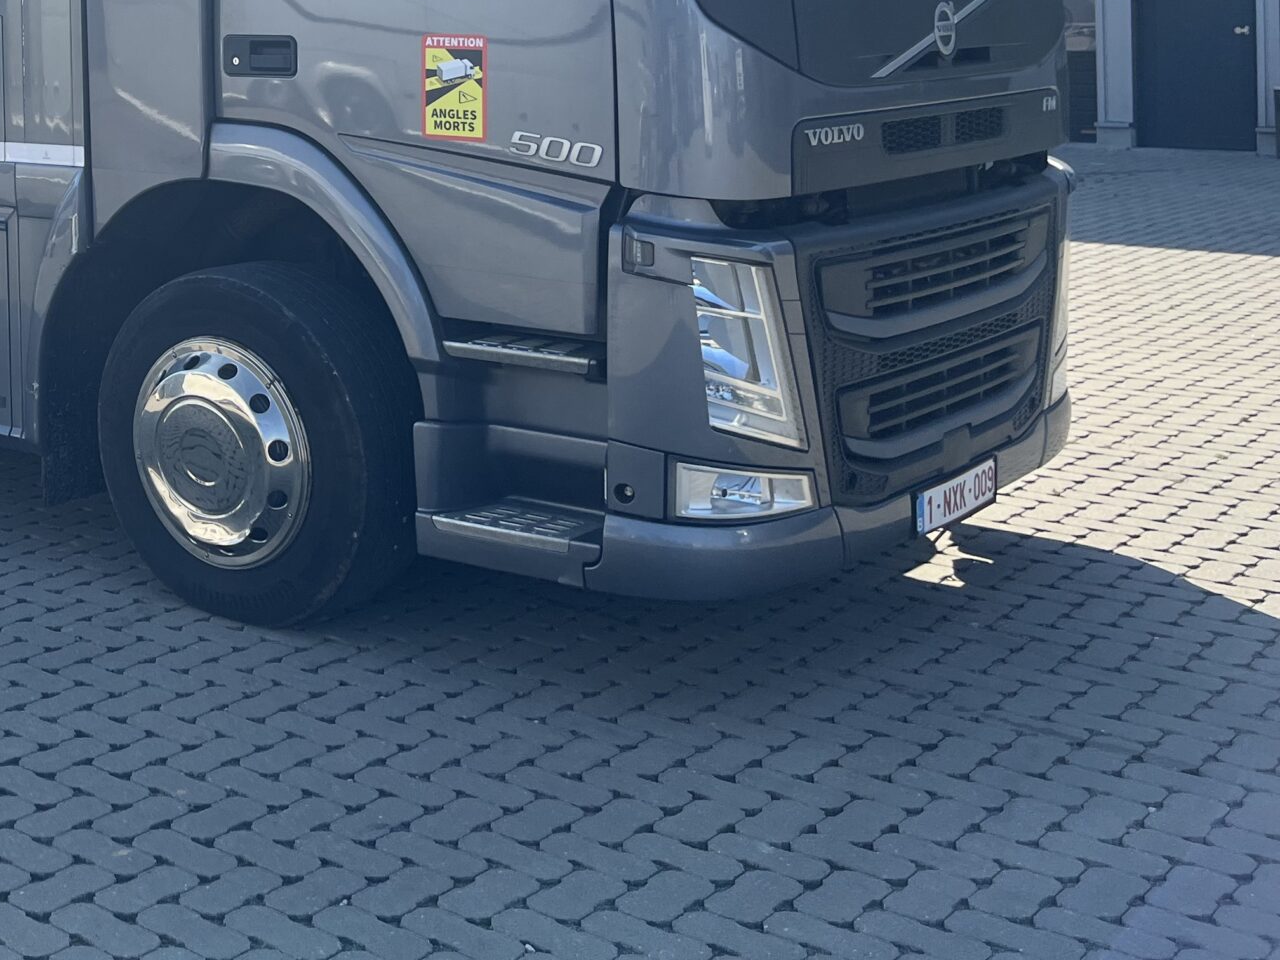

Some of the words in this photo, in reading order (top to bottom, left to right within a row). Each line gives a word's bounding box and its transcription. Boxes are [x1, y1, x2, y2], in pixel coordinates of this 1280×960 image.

[425, 37, 484, 47] ATTENTION
[1042, 95, 1057, 112] FM
[431, 108, 477, 120] ANGLES
[433, 120, 475, 132] MORTS
[804, 123, 865, 146] VOLVO
[509, 131, 603, 168] 500
[927, 466, 994, 524] 1-NXK-009
